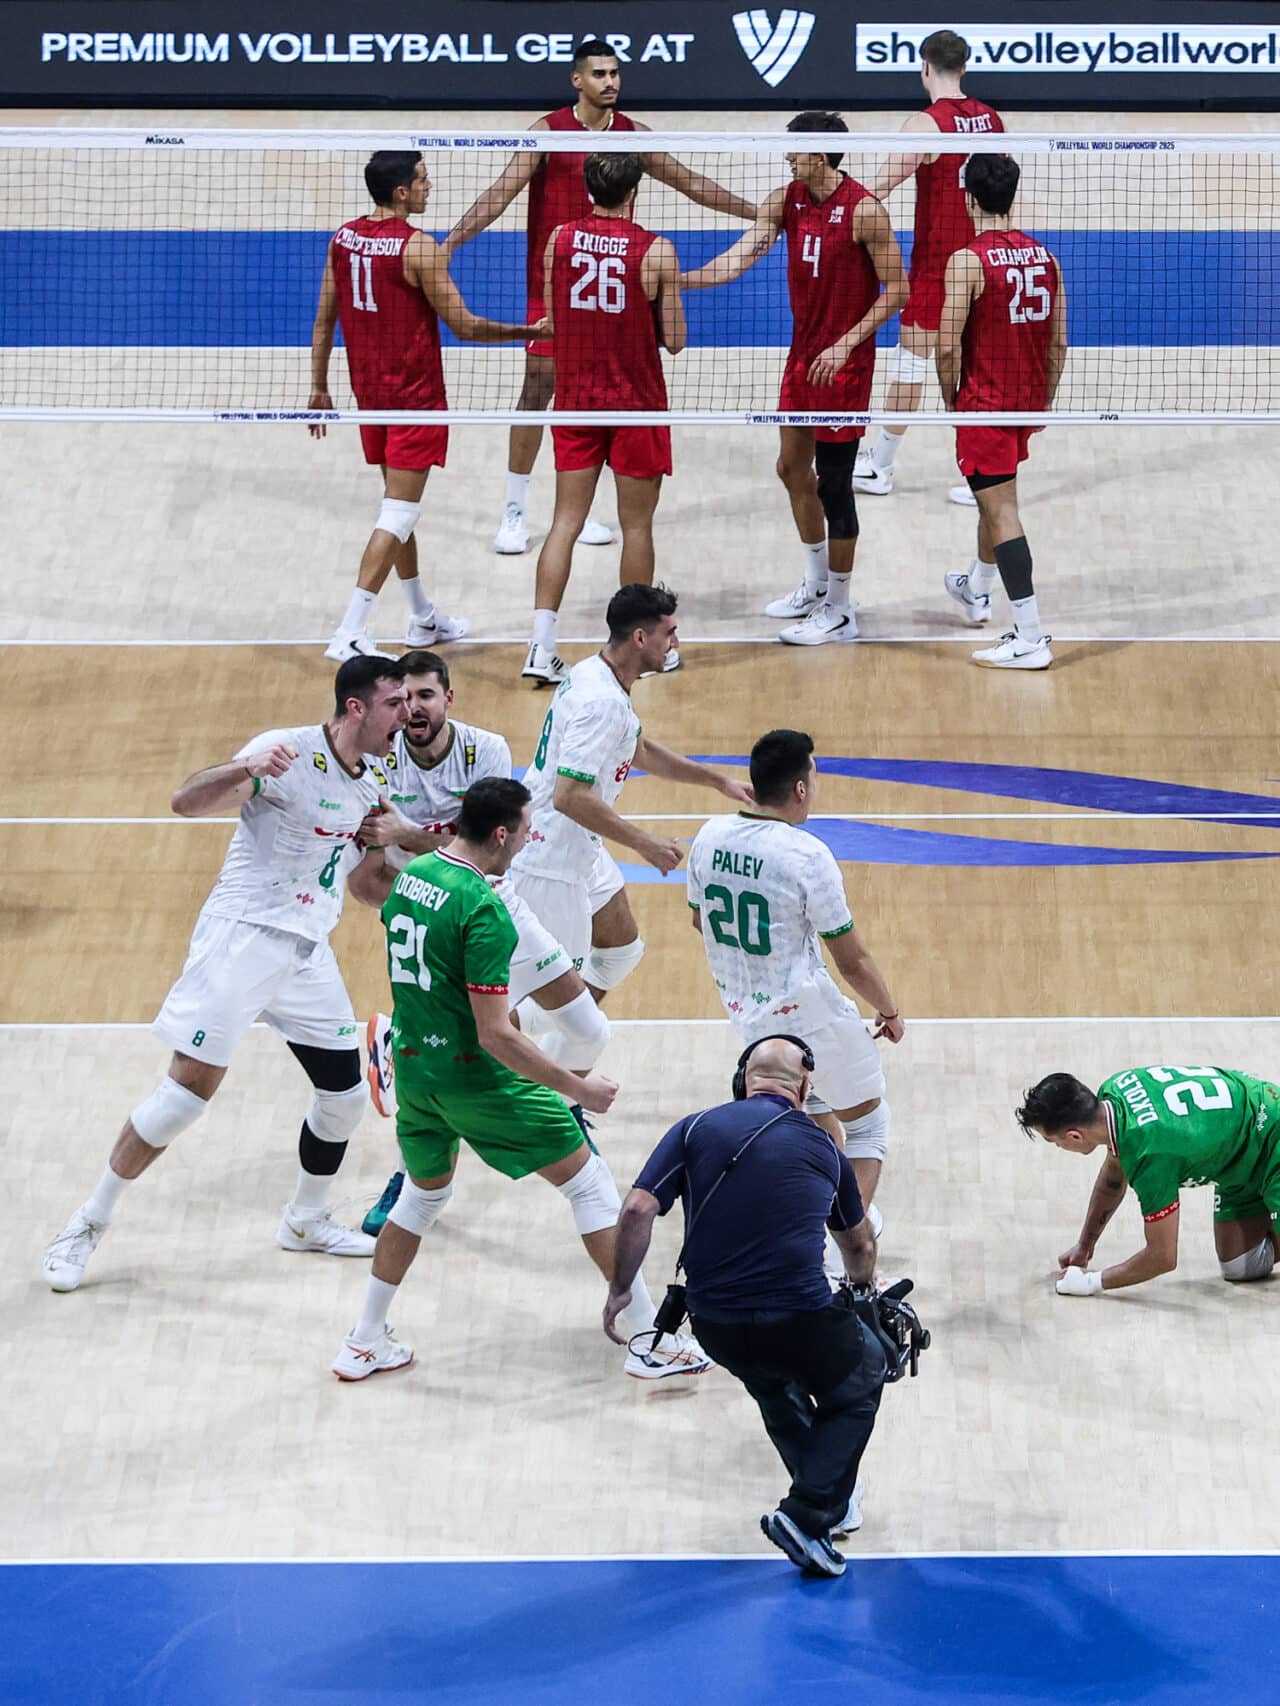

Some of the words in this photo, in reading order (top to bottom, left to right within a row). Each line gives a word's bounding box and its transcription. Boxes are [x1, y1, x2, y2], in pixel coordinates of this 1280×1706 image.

[41, 33, 229, 62] PREMIUM
[239, 33, 508, 62] VOLLEYBALL
[516, 34, 632, 62] GER
[639, 34, 695, 62] AT
[1056, 141, 1089, 150] VOLLEYBALL
[1091, 141, 1113, 150] WORLD
[1115, 141, 1157, 150] CHAMPIONSHIP
[572, 230, 629, 256] KNIGGE
[802, 234, 821, 278] 4
[349, 252, 378, 312] 11
[570, 252, 626, 314] 26
[1006, 265, 1051, 324] 25
[319, 845, 346, 889] 8
[712, 849, 764, 880] PALEV
[395, 873, 450, 912] DOBREV
[704, 883, 771, 956] 20
[390, 913, 432, 992] 21
[192, 1030, 205, 1047] 8
